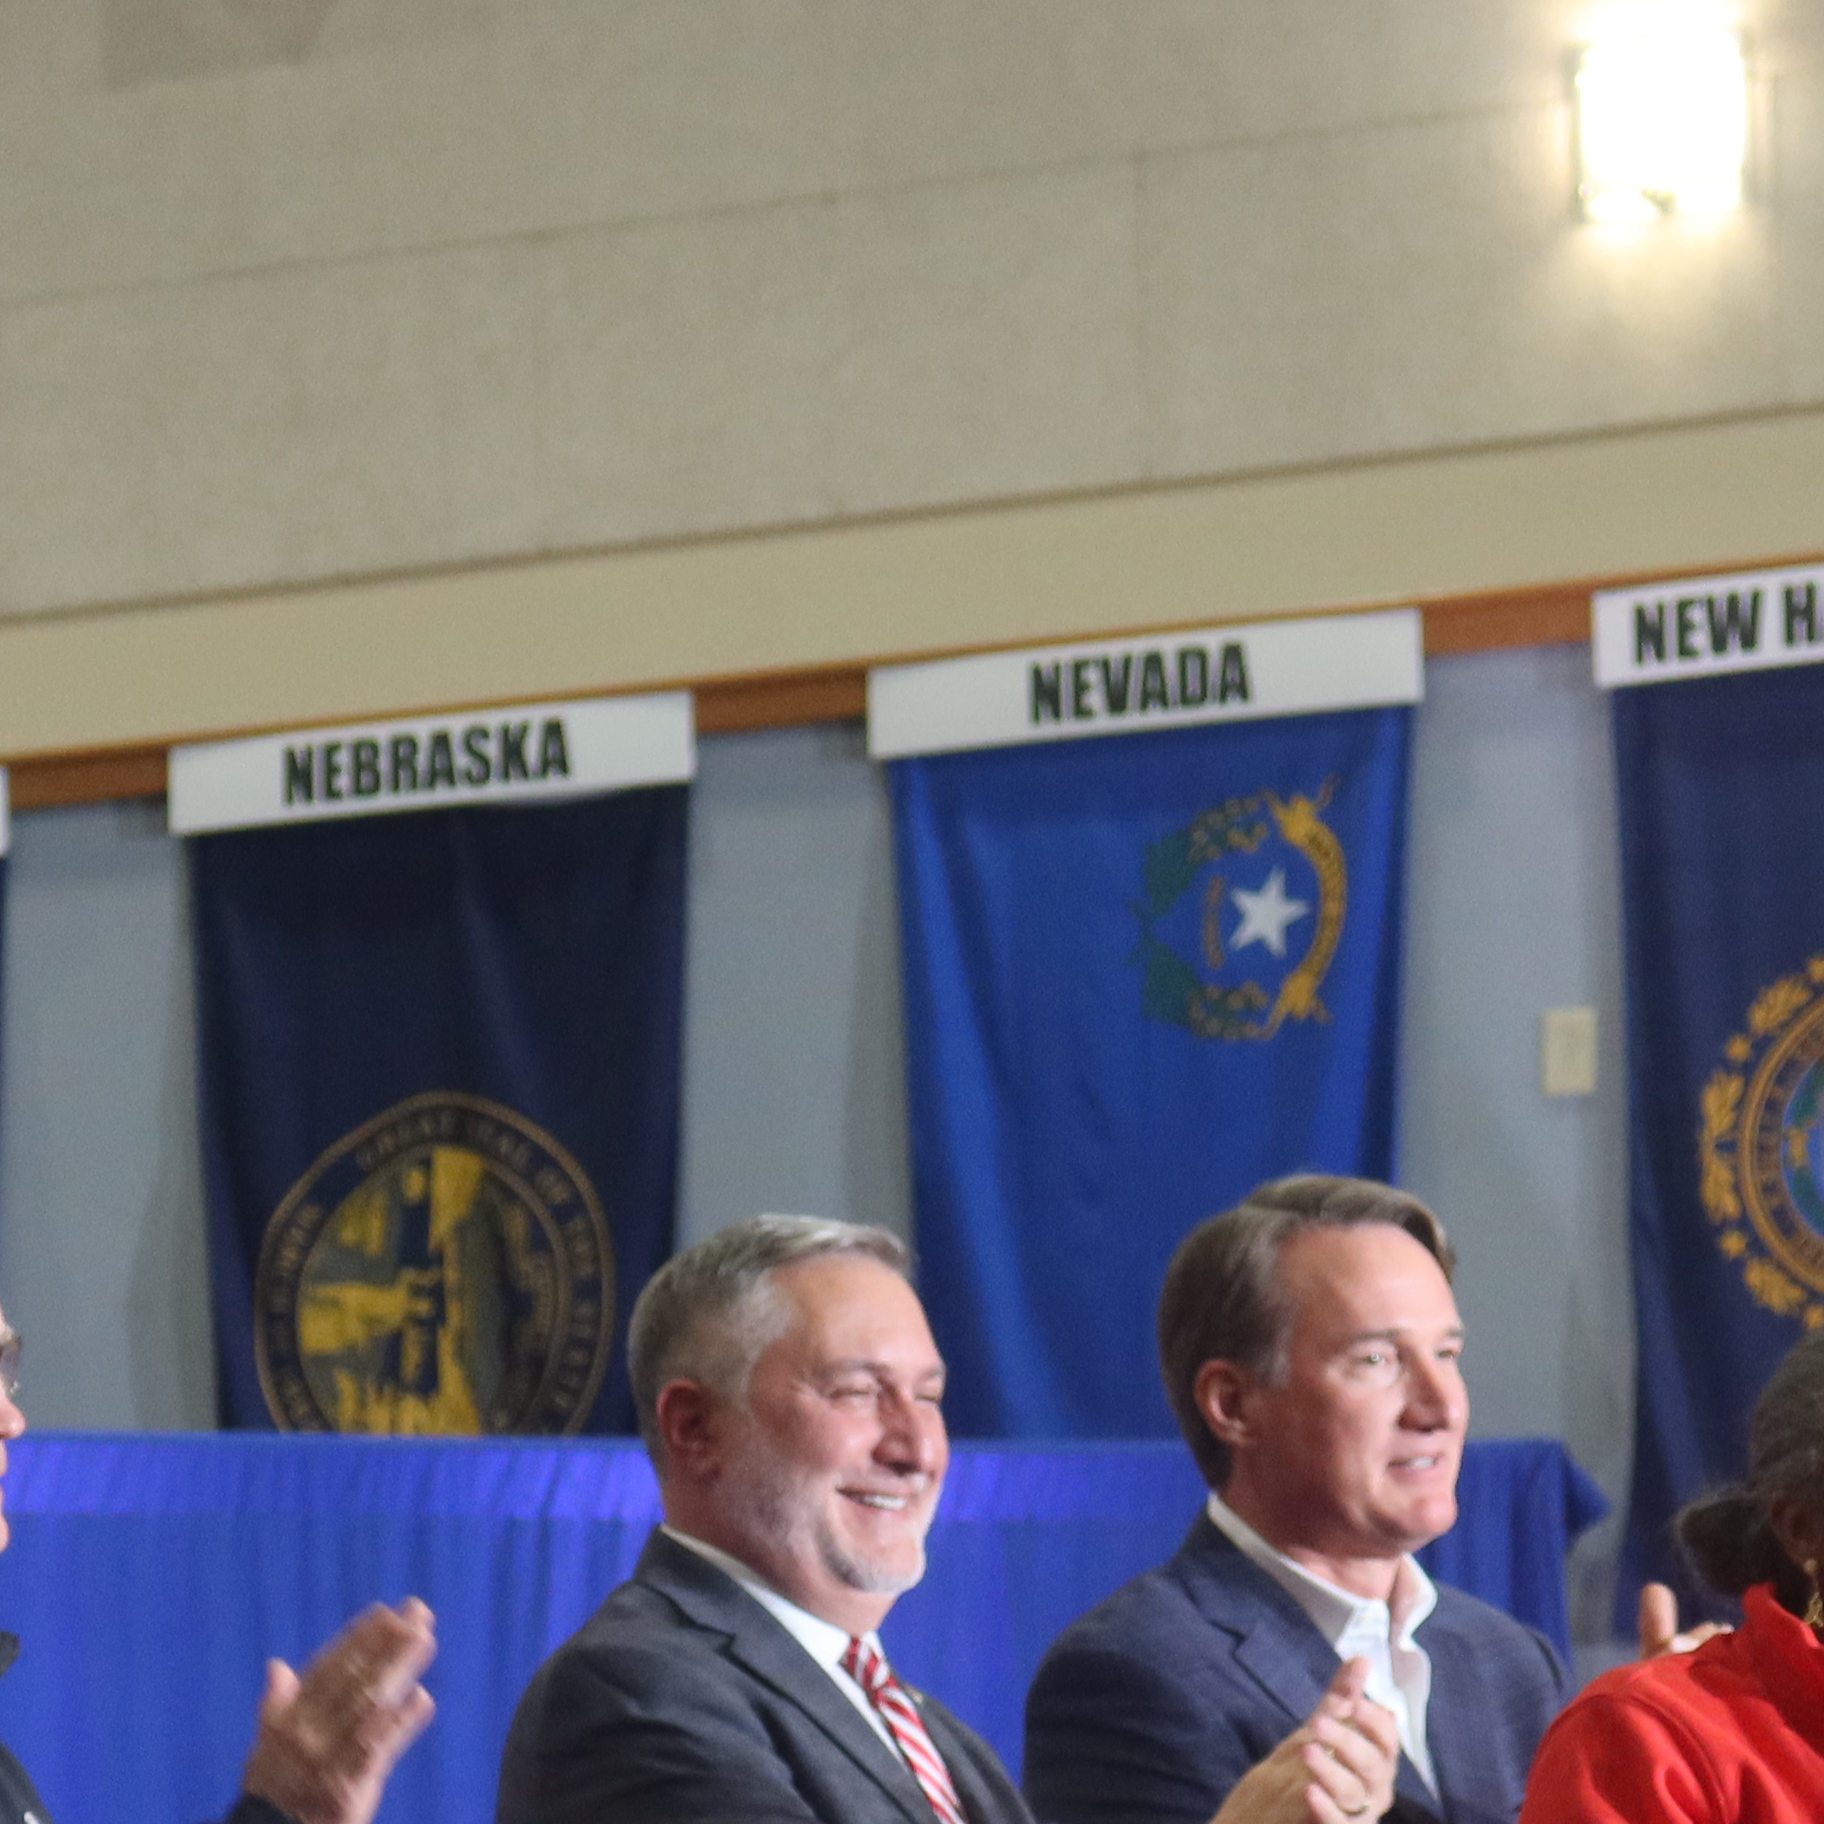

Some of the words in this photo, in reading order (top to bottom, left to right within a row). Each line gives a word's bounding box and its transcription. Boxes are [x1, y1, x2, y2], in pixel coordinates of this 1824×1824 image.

[1633, 590, 1762, 666] NEW
[1031, 642, 1250, 724] NEVADA
[282, 717, 570, 806] NEBRASKA
